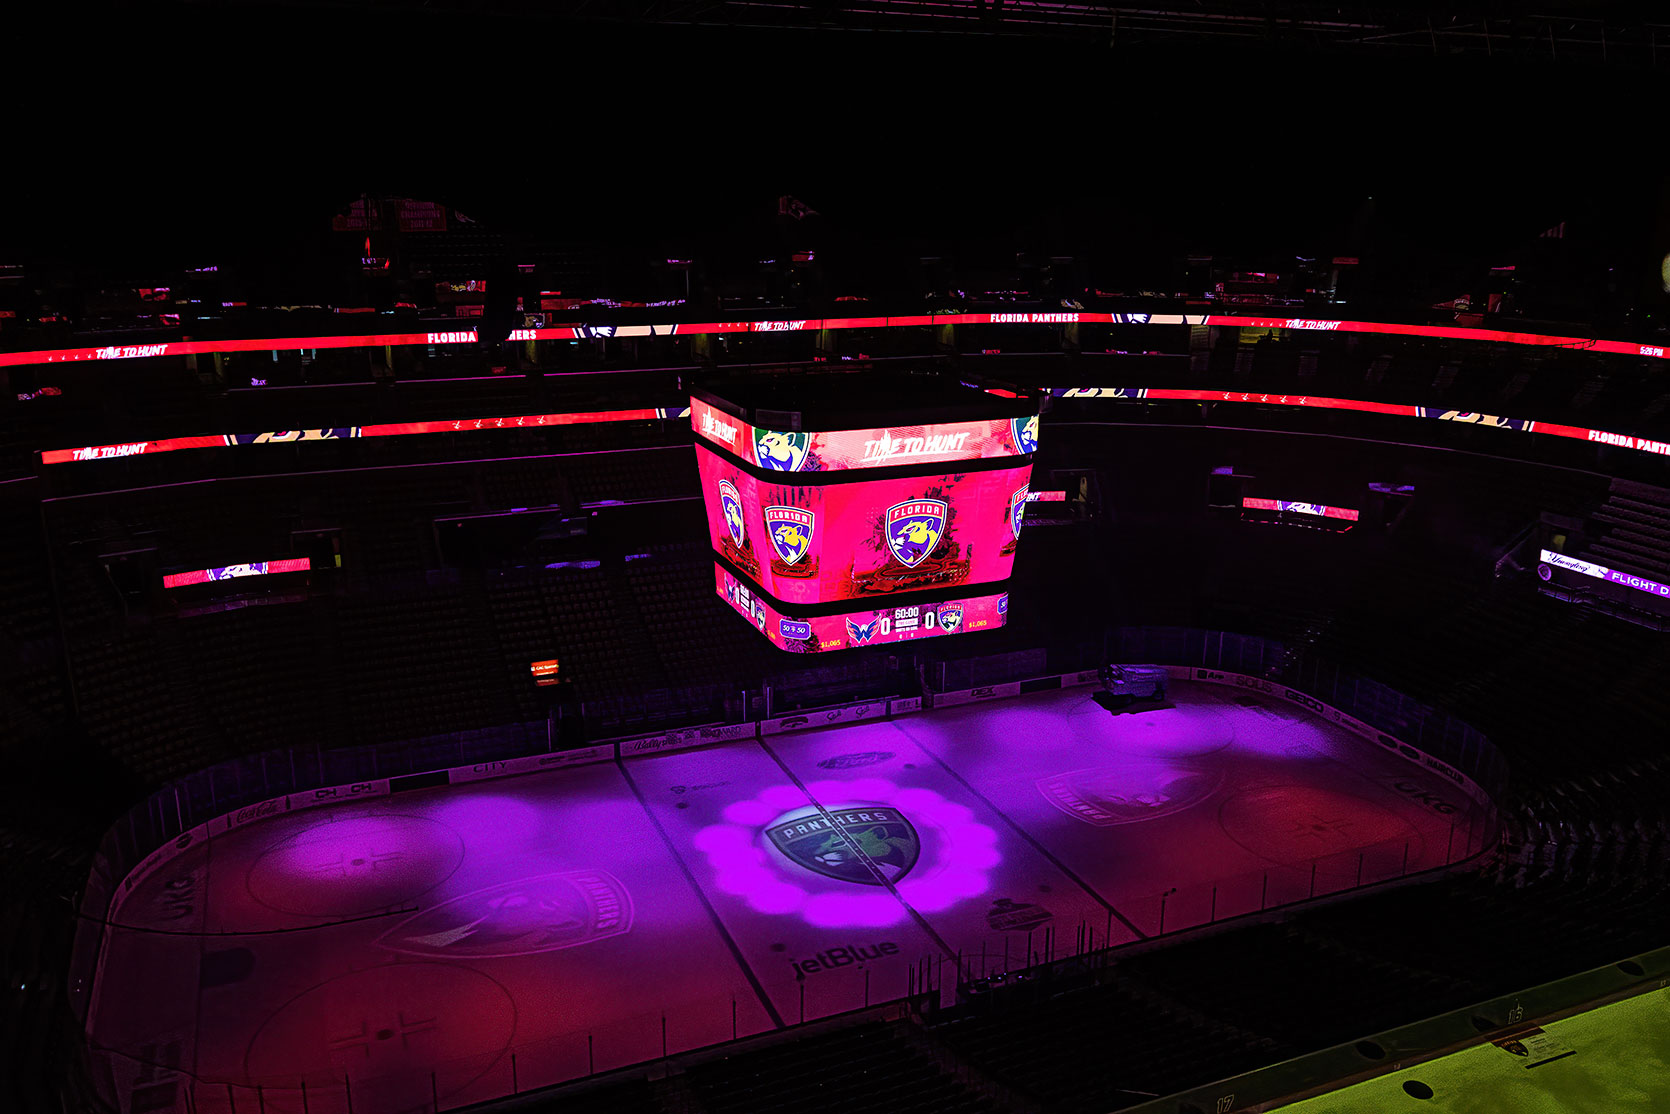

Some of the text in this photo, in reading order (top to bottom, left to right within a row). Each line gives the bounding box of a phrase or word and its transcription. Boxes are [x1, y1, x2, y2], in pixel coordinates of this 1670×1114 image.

[990, 313, 1079, 322] FLORIDA PANTHERS
[755, 321, 773, 331] TIME
[774, 322, 784, 330] TO
[1286, 319, 1341, 330] TIME TO HUNT
[427, 332, 476, 344] FLORIDA
[95, 344, 168, 359] TIME TO HUNT
[1653, 348, 1664, 356] PM
[863, 429, 970, 462] TIME TO HUNT
[1588, 430, 1633, 448] FLORIDA
[73, 443, 148, 460] TIME TO HUNT
[769, 511, 807, 523] FLORIDA
[894, 504, 940, 519] FLORIDA
[1611, 572, 1657, 592] FLIGHT
[895, 607, 919, 619] 60:00
[880, 617, 891, 635] 0
[925, 612, 935, 630] 0
[796, 626, 806, 634] 50
[820, 640, 841, 648] $1,065
[971, 687, 995, 697] DEX
[1285, 689, 1324, 713] GEICO
[473, 761, 508, 773] CITY
[783, 812, 888, 839] PANTHERS
[788, 942, 900, 981] jetBlue
